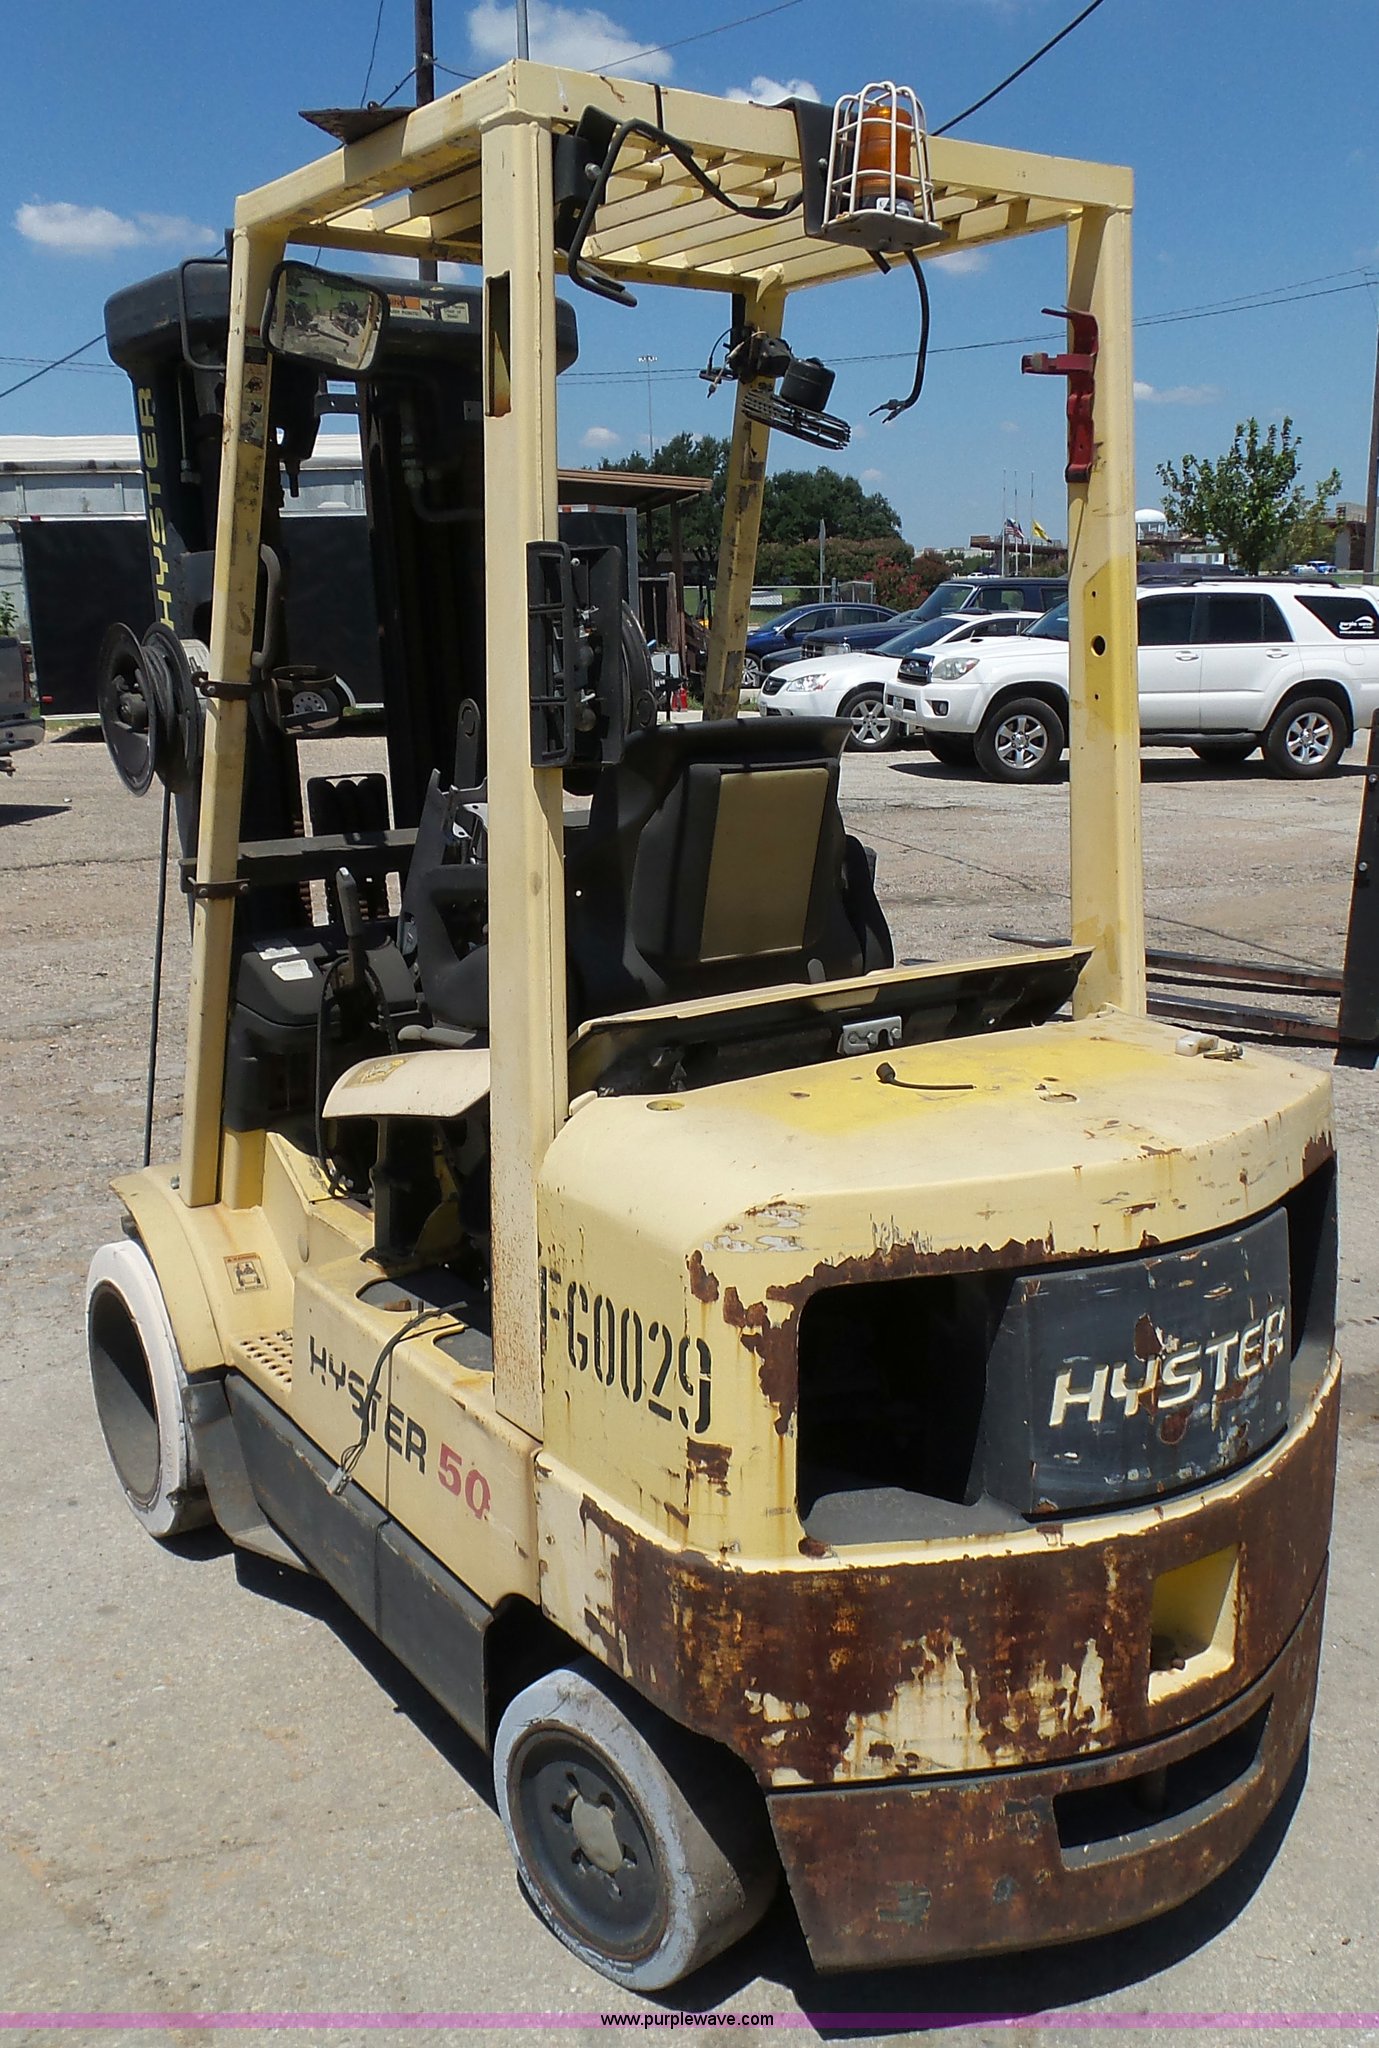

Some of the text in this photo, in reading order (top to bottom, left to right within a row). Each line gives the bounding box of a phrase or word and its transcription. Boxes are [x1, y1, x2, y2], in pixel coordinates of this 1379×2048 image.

[137, 387, 175, 632] HYSTER
[309, 1334, 492, 1520] HYSTER 50
[1048, 1304, 1287, 1427] HYSTER
